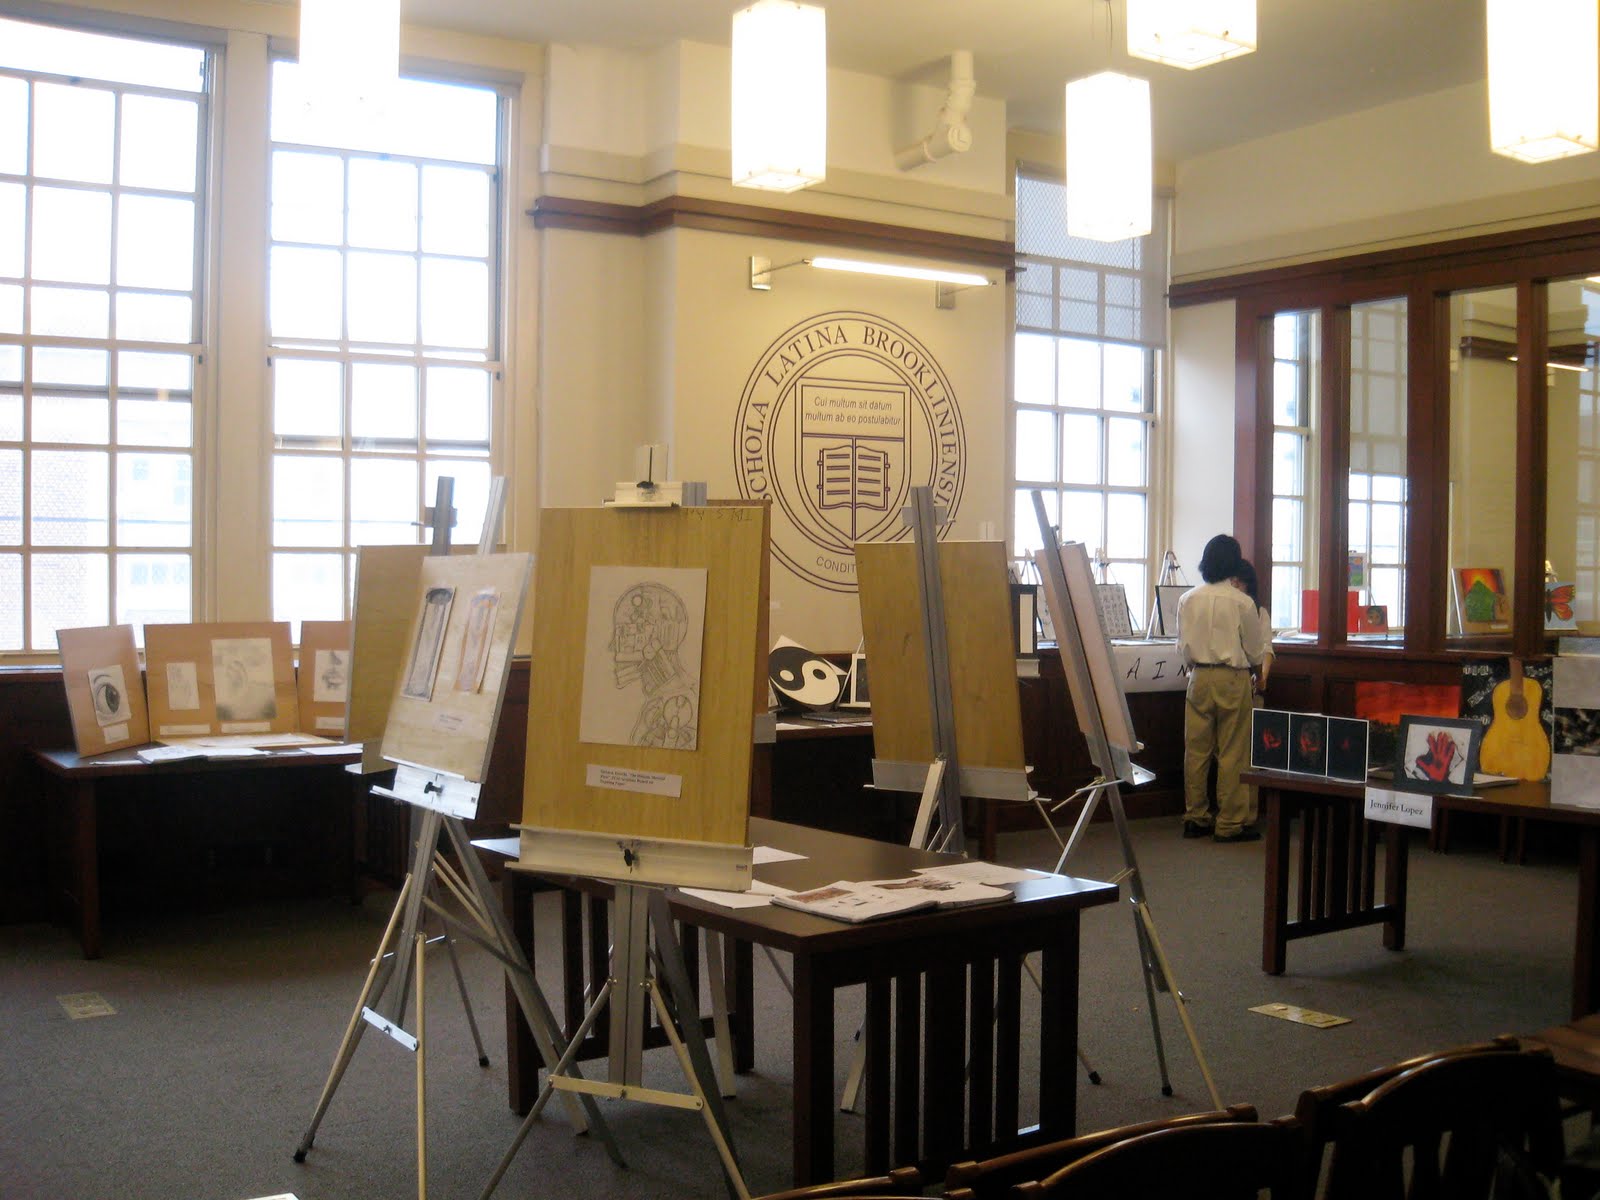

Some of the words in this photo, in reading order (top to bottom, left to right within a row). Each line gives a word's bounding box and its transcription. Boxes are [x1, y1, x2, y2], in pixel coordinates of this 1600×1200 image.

[814, 396, 828, 407] Cui
[829, 398, 857, 409] multum
[859, 400, 868, 410] sit
[869, 401, 892, 411] datum
[764, 324, 848, 387] LATINA
[862, 326, 957, 504] BROOKLINIENSI
[805, 411, 834, 421] multum
[835, 412, 845, 422] ab
[858, 415, 901, 426] postulabitur
[1370, 799, 1399, 812] Jennifer
[1400, 804, 1424, 816] Lopez
